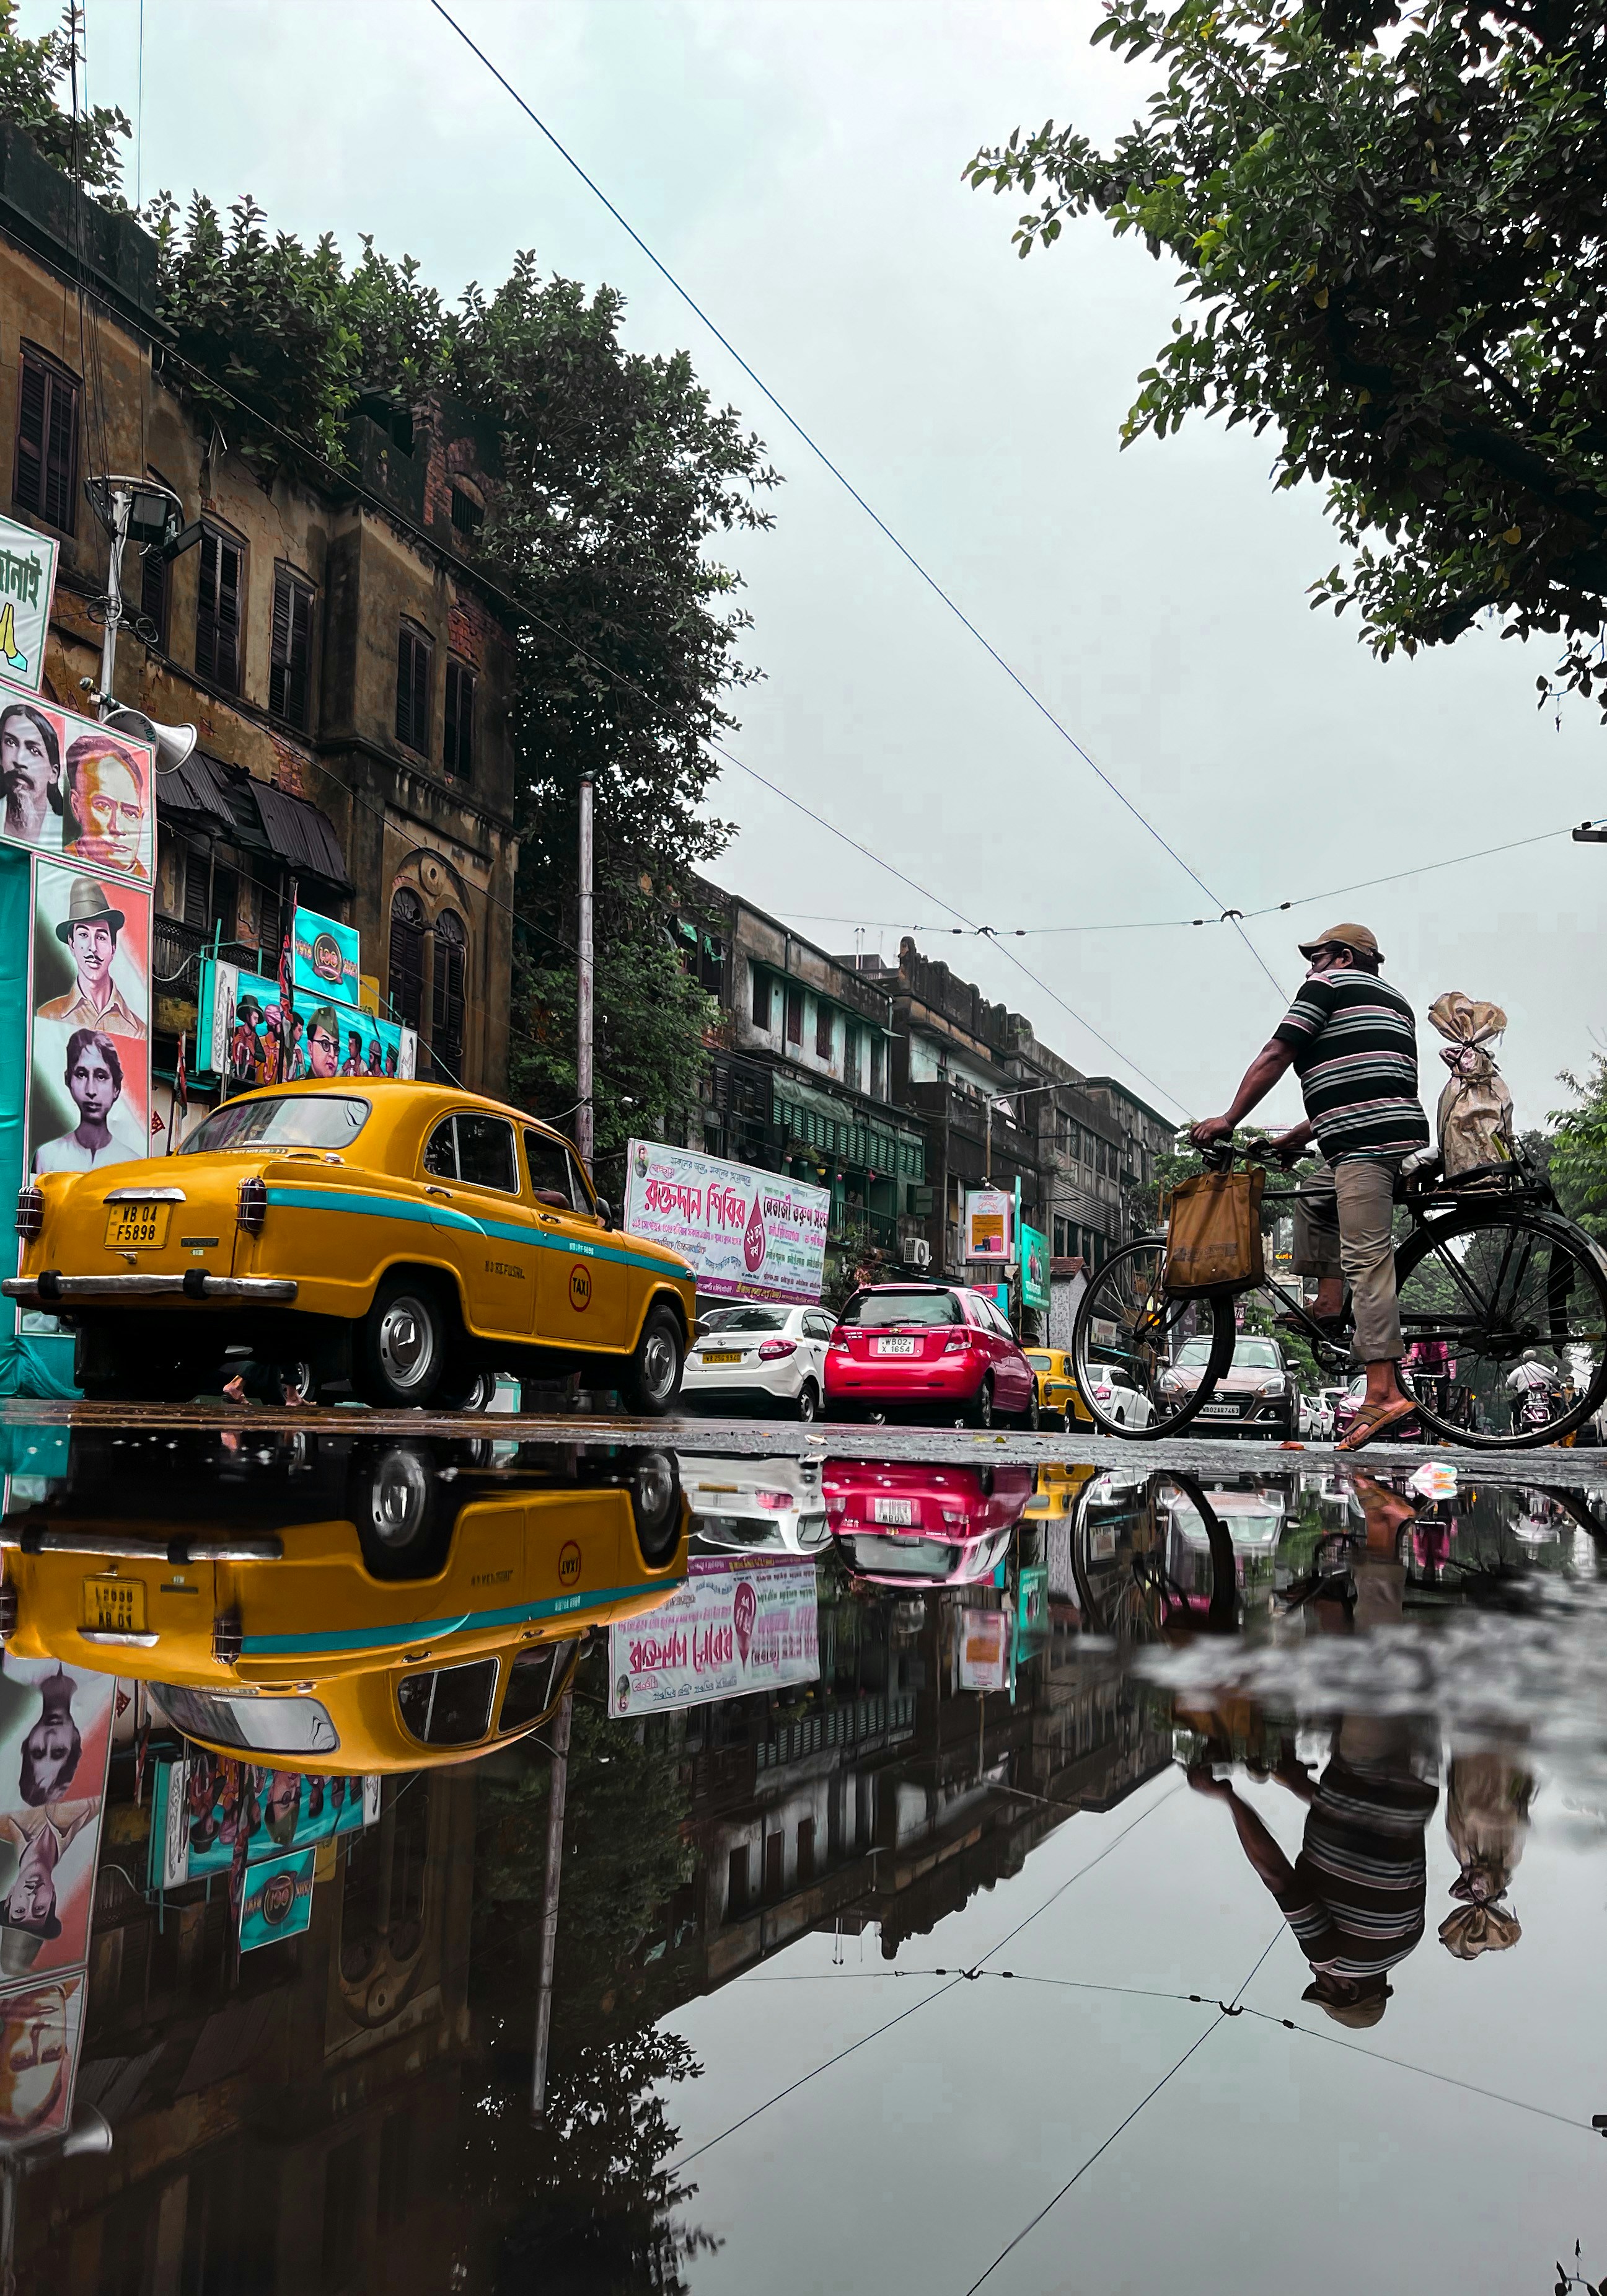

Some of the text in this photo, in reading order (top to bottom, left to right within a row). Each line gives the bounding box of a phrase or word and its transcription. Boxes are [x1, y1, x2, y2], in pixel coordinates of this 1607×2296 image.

[645, 1178, 745, 1230] রক্তদান শিবির
[123, 1206, 157, 1222] WB 04
[117, 1224, 156, 1240] F5898
[572, 1278, 589, 1297] TAXI
